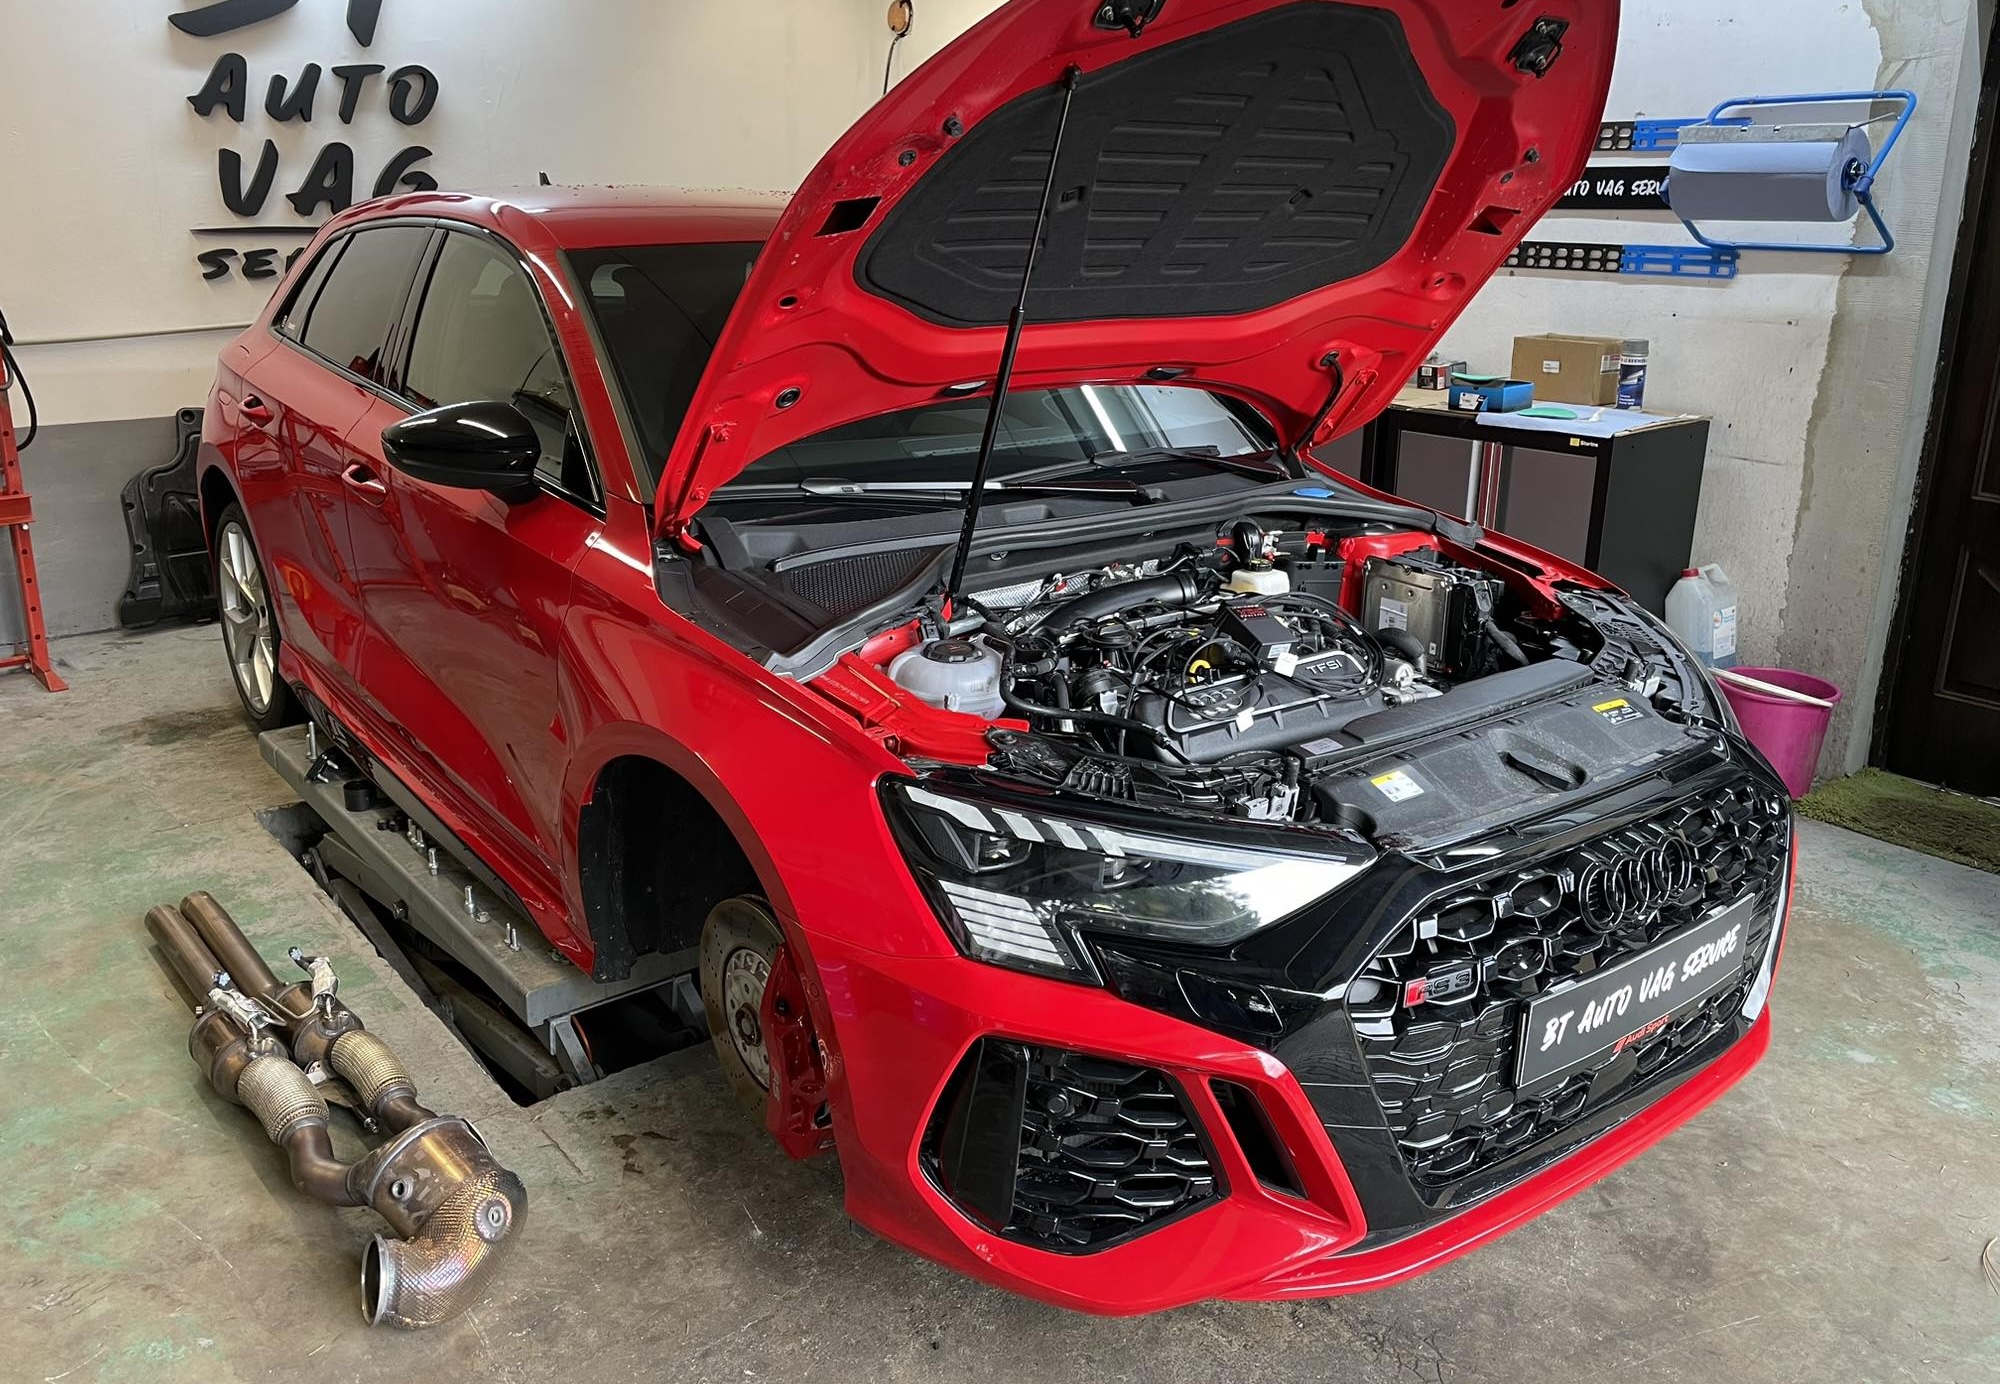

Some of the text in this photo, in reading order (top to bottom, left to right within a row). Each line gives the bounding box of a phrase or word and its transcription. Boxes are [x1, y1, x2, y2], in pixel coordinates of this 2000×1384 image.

[187, 53, 439, 125] AUTO
[218, 139, 438, 216] VAG
[1596, 179, 1624, 196] VAG
[1306, 659, 1343, 675] TFSI
[1416, 970, 1471, 999] RS 3
[1540, 923, 1741, 1051] BT AUTO VAG SERVICE
[1625, 1014, 1670, 1046] Audi Sport
